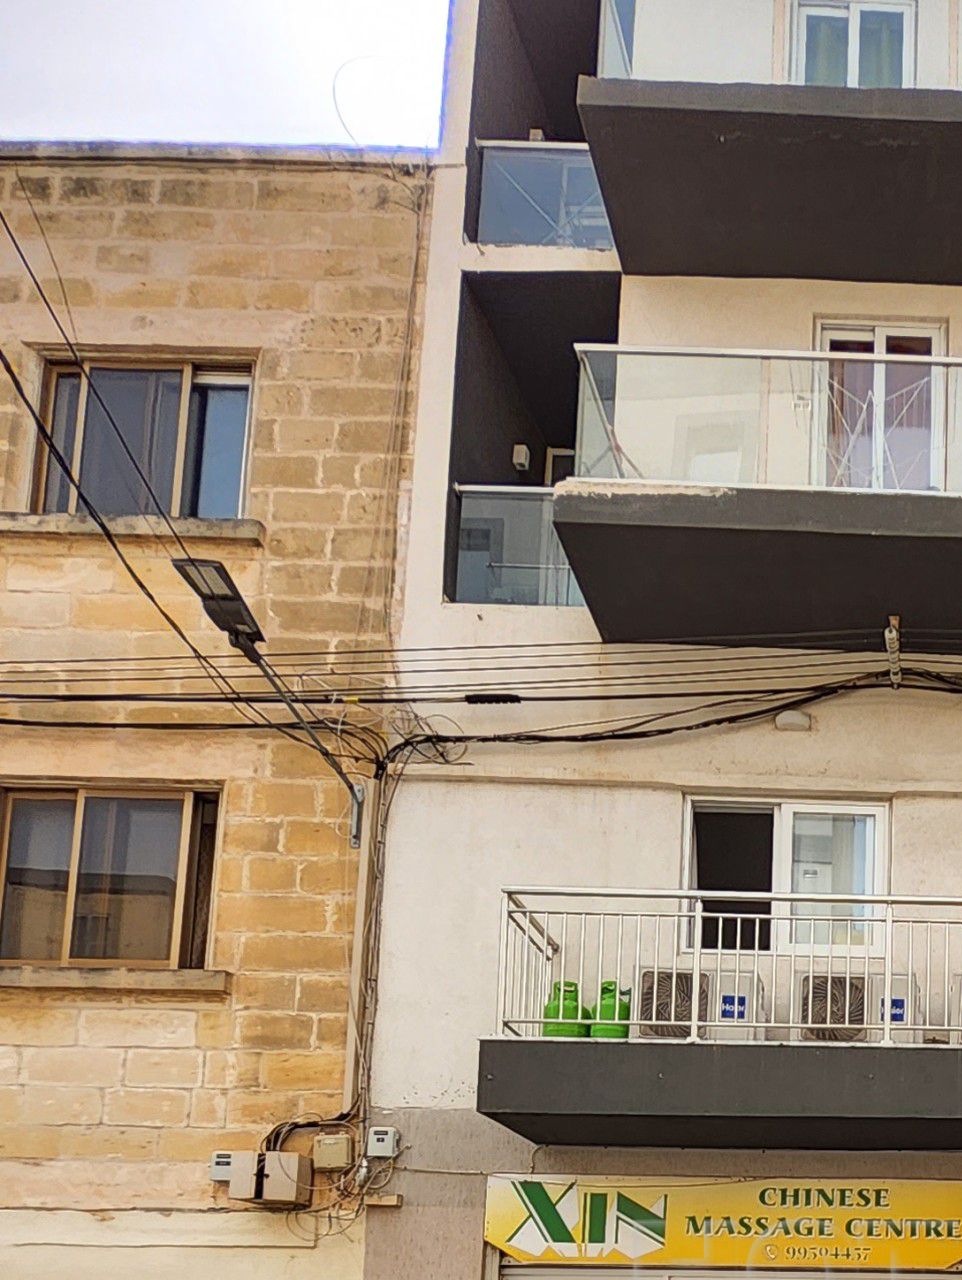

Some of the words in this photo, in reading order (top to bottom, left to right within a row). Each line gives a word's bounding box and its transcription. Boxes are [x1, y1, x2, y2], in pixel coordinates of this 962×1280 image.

[758, 1186, 893, 1208] CHINESE
[505, 1180, 667, 1247] XIN
[685, 1215, 838, 1238] MASSAGE
